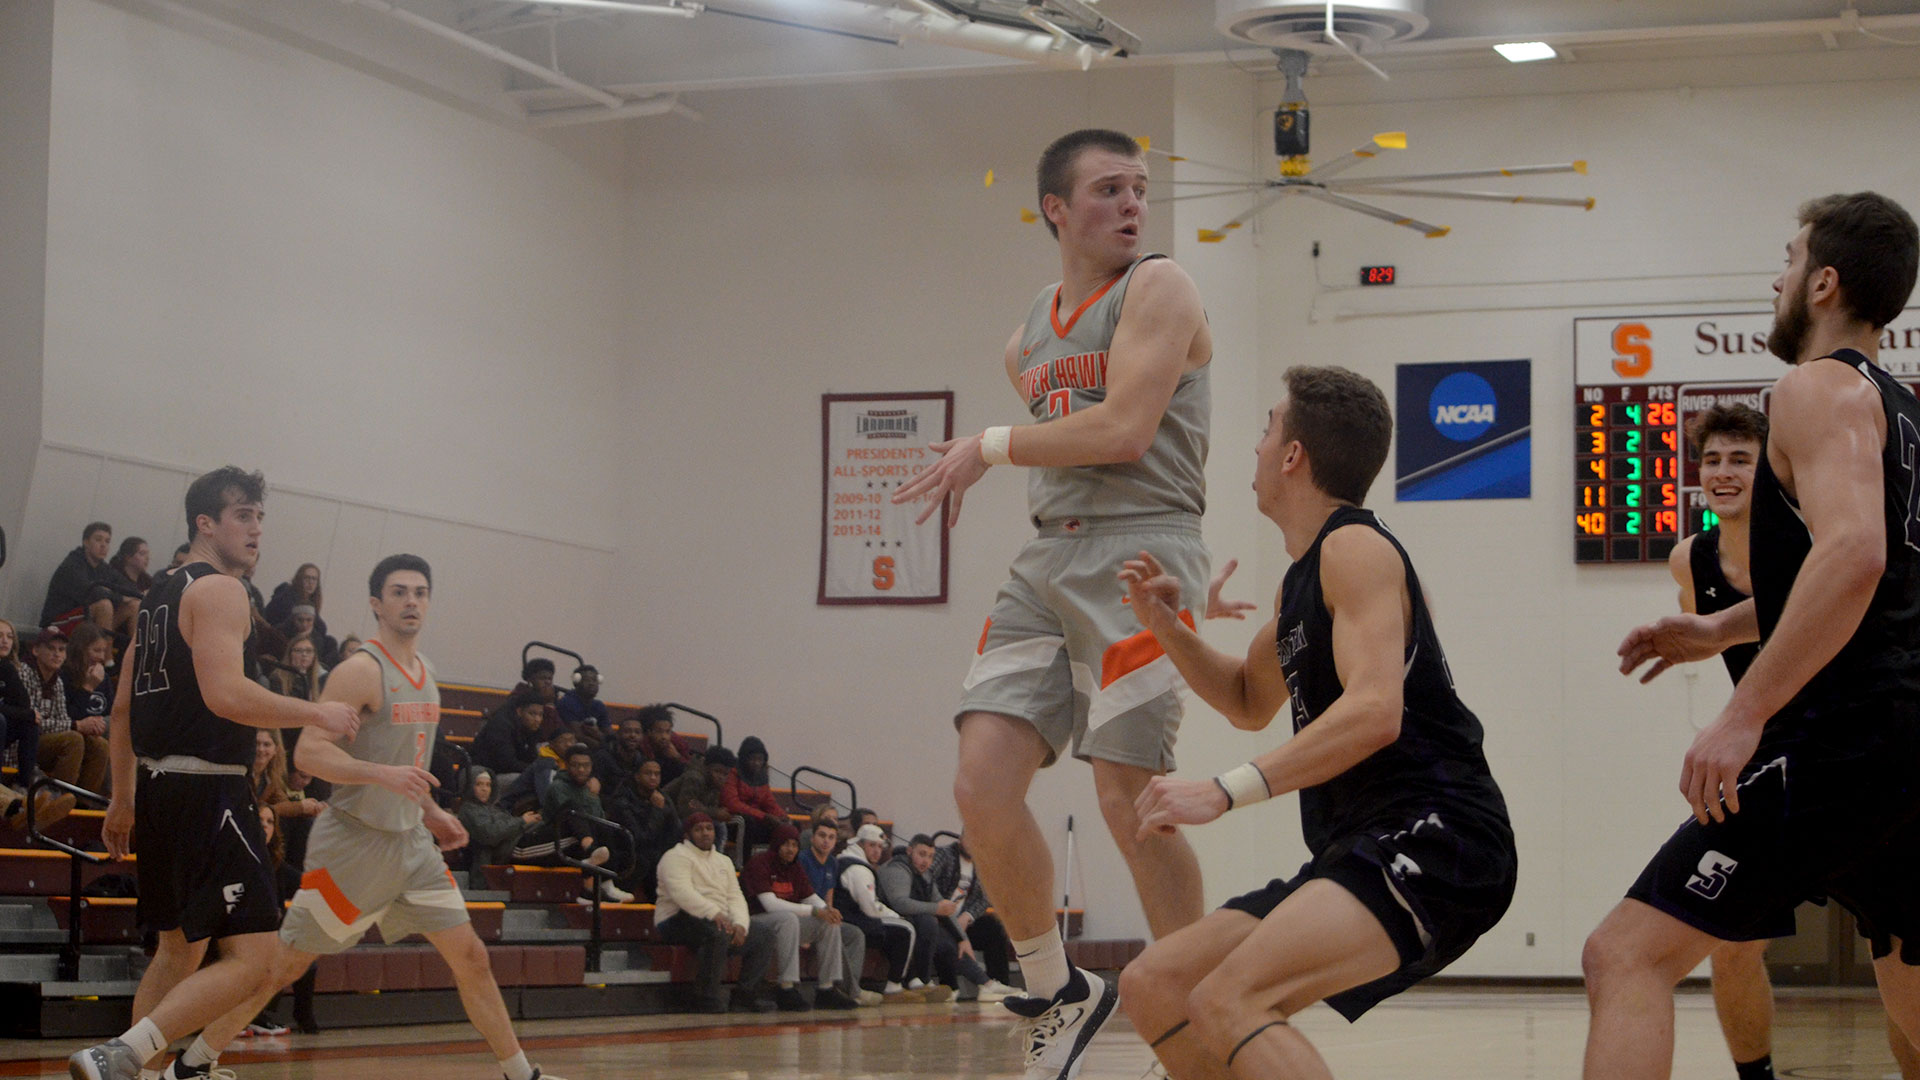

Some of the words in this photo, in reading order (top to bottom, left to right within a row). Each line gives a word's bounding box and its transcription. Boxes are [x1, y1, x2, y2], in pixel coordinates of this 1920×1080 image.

[1695, 321, 1767, 355] Sus
[1611, 322, 1652, 378] S
[1584, 387, 1604, 402] NO
[1621, 386, 1630, 400] F
[1648, 385, 1674, 400] PTS
[1682, 395, 1716, 411] RIVER
[1435, 404, 1496, 424] NCAA
[1590, 404, 1605, 427] 2
[1626, 404, 1642, 426] 4
[1647, 402, 1677, 426] 26
[1591, 431, 1605, 454] 3
[1626, 430, 1642, 453] 2
[1661, 430, 1677, 451] 4
[847, 448, 925, 459] PRESIDENT'S
[833, 464, 909, 477] ALL-SPORTS
[1590, 459, 1605, 480] 4
[1655, 457, 1677, 479] 11
[834, 492, 882, 504] 2009-10
[1584, 486, 1605, 508] 11
[1626, 484, 1642, 508] 2
[1661, 483, 1677, 507] 5
[834, 508, 881, 520] 2011-12
[1577, 512, 1605, 535] 40
[1626, 511, 1642, 535] 2
[1655, 511, 1677, 533] 19
[833, 524, 881, 536] 2013-14
[872, 556, 895, 590] S
